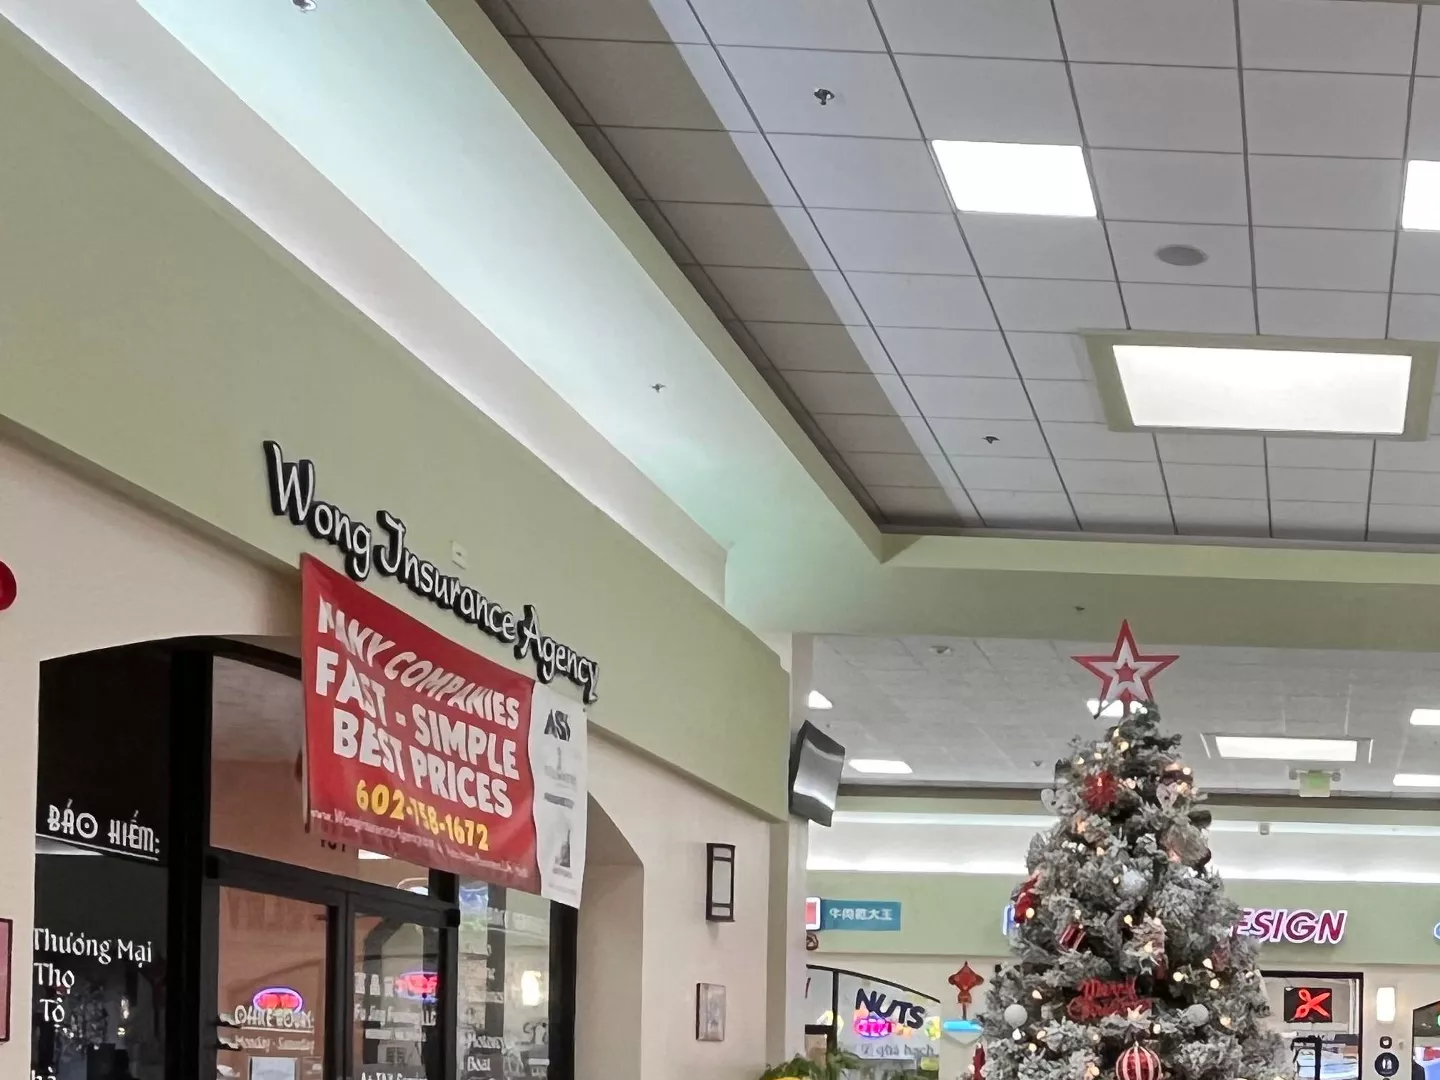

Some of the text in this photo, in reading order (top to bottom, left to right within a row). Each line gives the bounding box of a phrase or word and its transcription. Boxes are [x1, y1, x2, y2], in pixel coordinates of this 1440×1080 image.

[263, 441, 600, 704] Wong Insurance Agency
[315, 646, 387, 726] FAST
[411, 703, 521, 781] SIMPLE
[384, 651, 520, 730] COMPANIES
[333, 708, 513, 819] BEST PRICES
[1228, 908, 1348, 945] ESIGN
[855, 988, 926, 1030] NUTS
